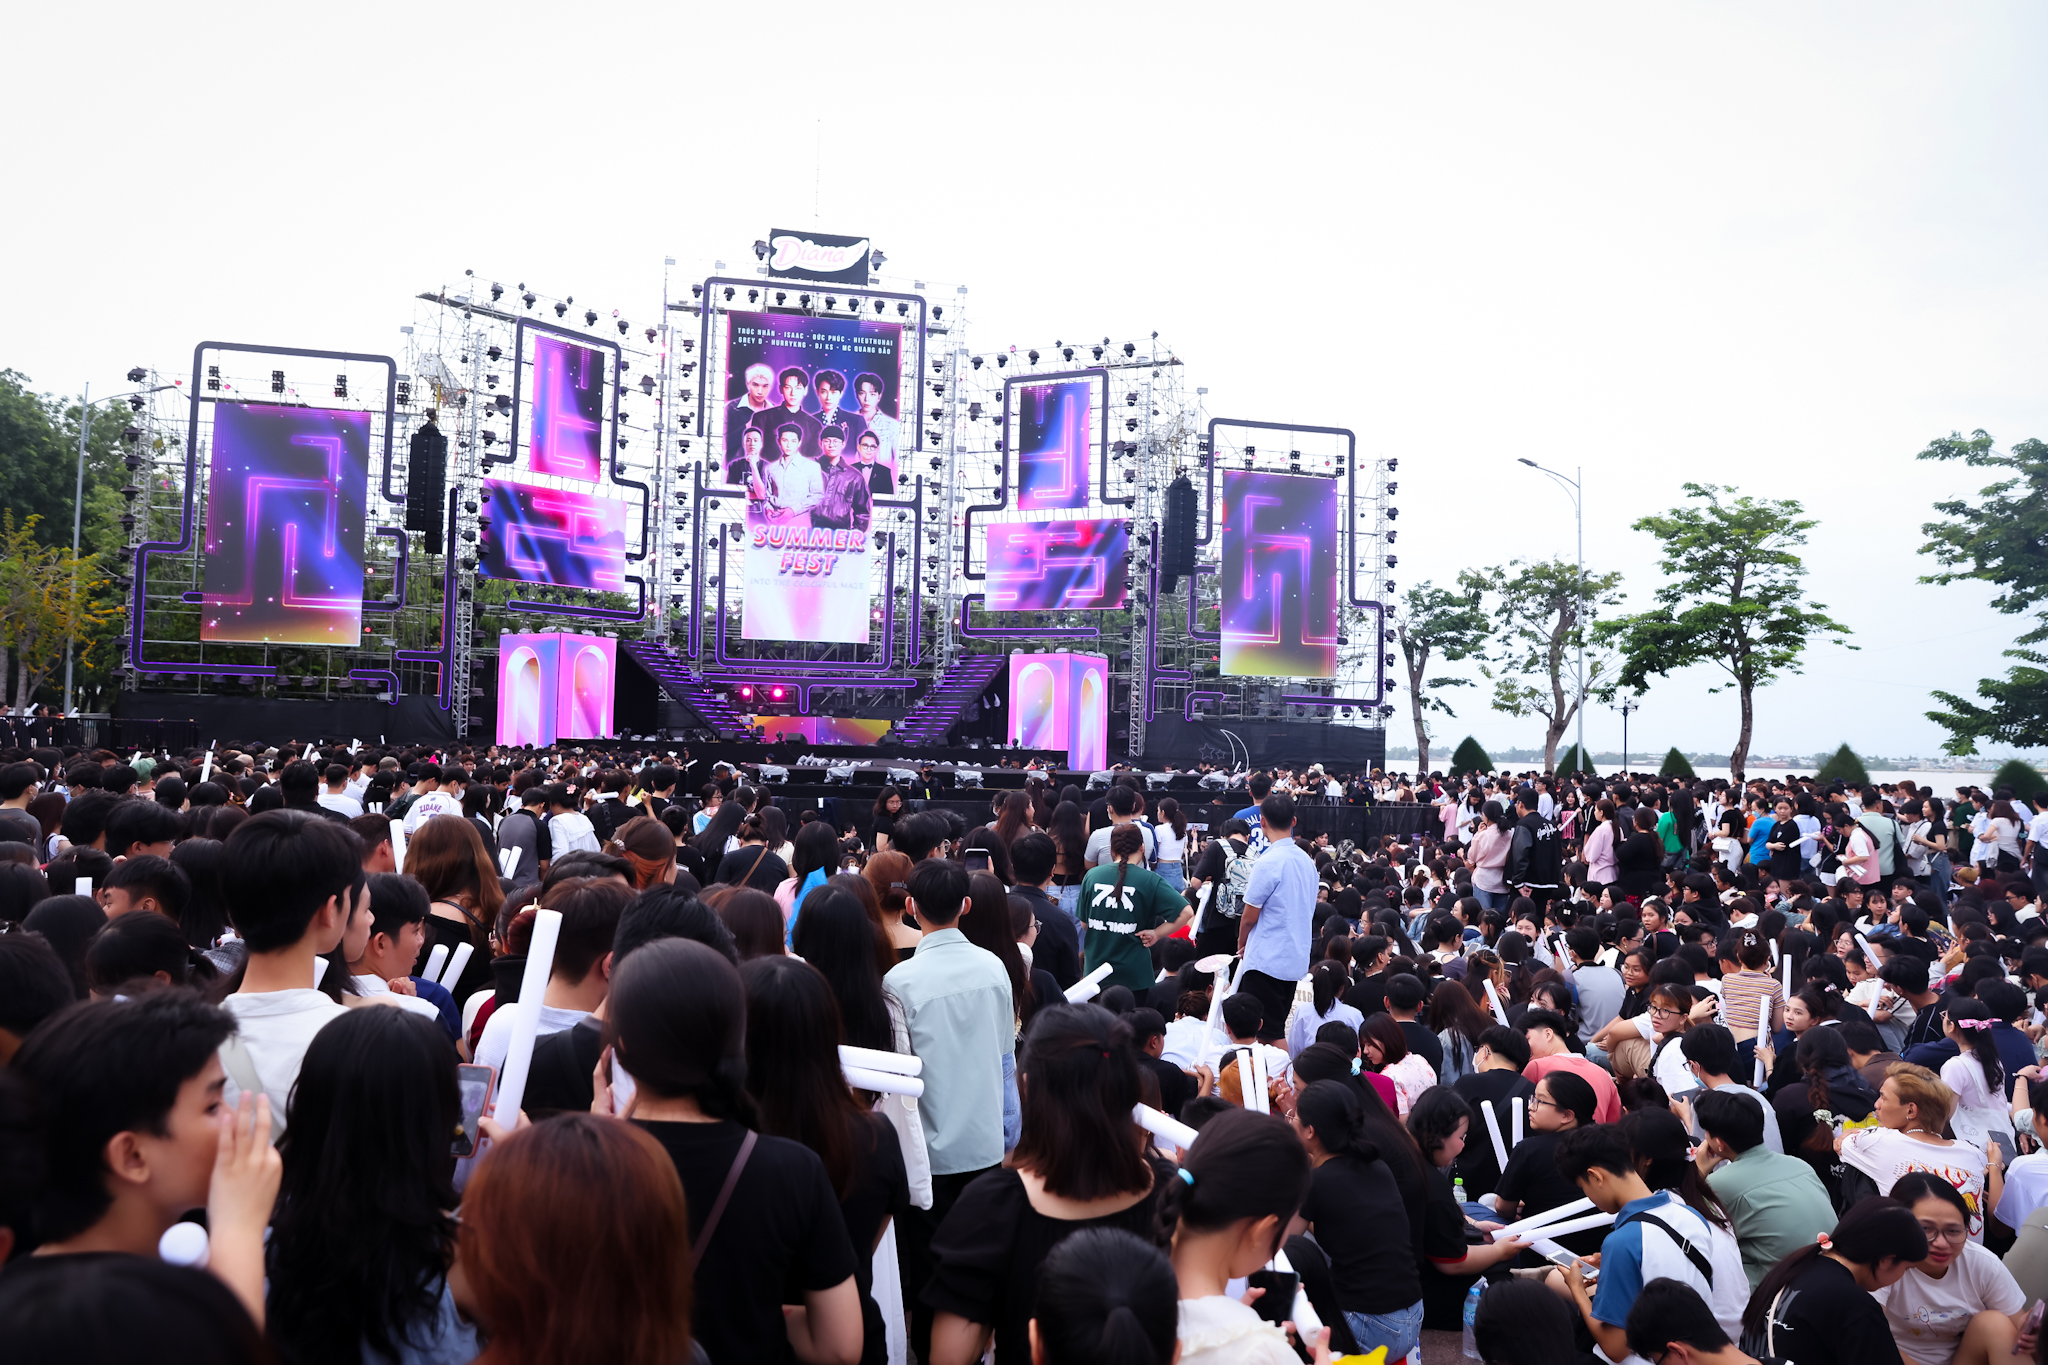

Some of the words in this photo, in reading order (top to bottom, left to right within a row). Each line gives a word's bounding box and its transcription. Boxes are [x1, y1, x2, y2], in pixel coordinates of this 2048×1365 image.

[775, 240, 845, 267] Diana
[738, 336, 755, 344] GREY
[771, 339, 806, 348] HURRYKNG
[815, 342, 822, 350] DJ
[854, 345, 876, 354] QUANG
[784, 331, 804, 339] ISAAC
[853, 337, 893, 346] HIEUTHUHAI
[753, 524, 866, 552] SUMMER
[780, 552, 838, 576] FEST
[750, 578, 771, 586] INTO
[774, 579, 790, 587] THE
[793, 579, 838, 588] COLORFUL
[840, 581, 864, 590] MAZE
[419, 803, 442, 813] ZIDANE
